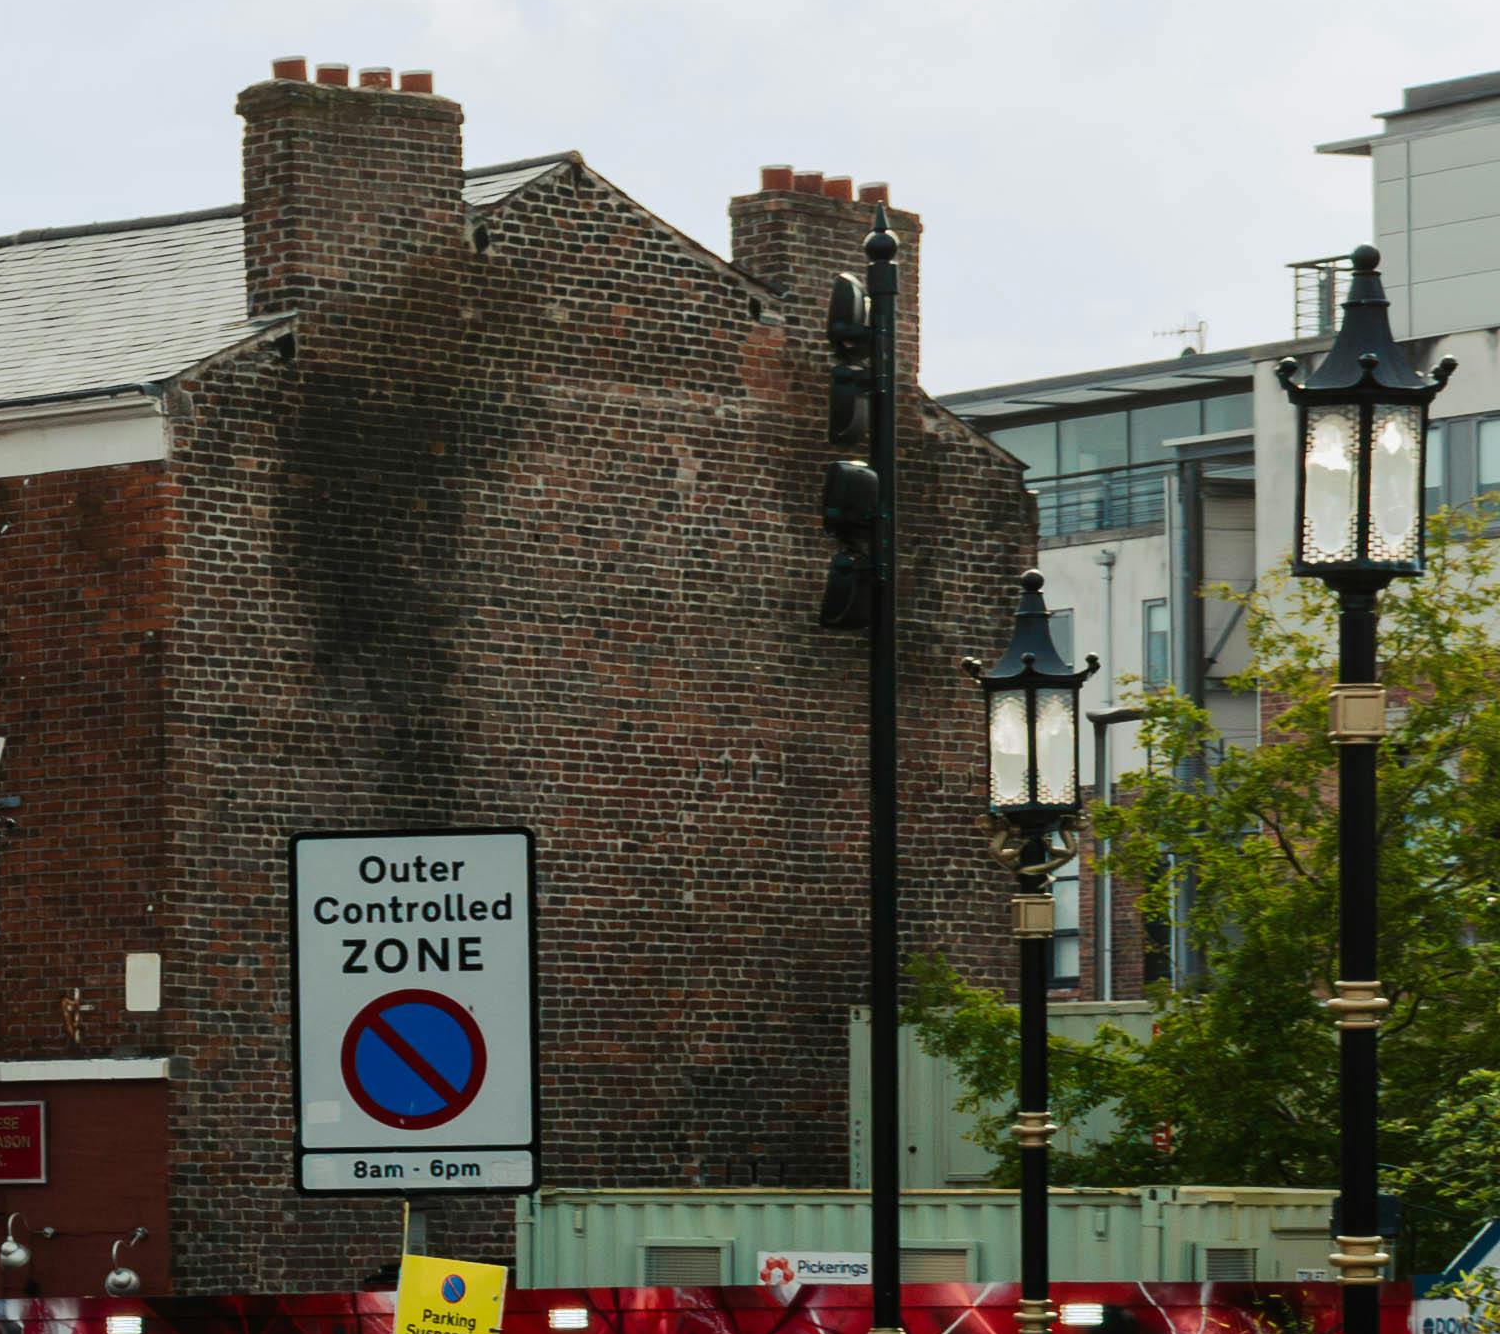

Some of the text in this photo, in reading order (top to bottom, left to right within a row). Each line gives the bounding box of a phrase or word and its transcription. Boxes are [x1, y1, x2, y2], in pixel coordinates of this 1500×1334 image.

[359, 855, 465, 884] Outer
[313, 892, 513, 925] Controlled
[342, 936, 485, 974] ZONE
[353, 1160, 404, 1179] 8am
[429, 1159, 482, 1181] 6pm
[797, 1260, 869, 1277] Pickerings
[422, 1308, 477, 1330] Parking
